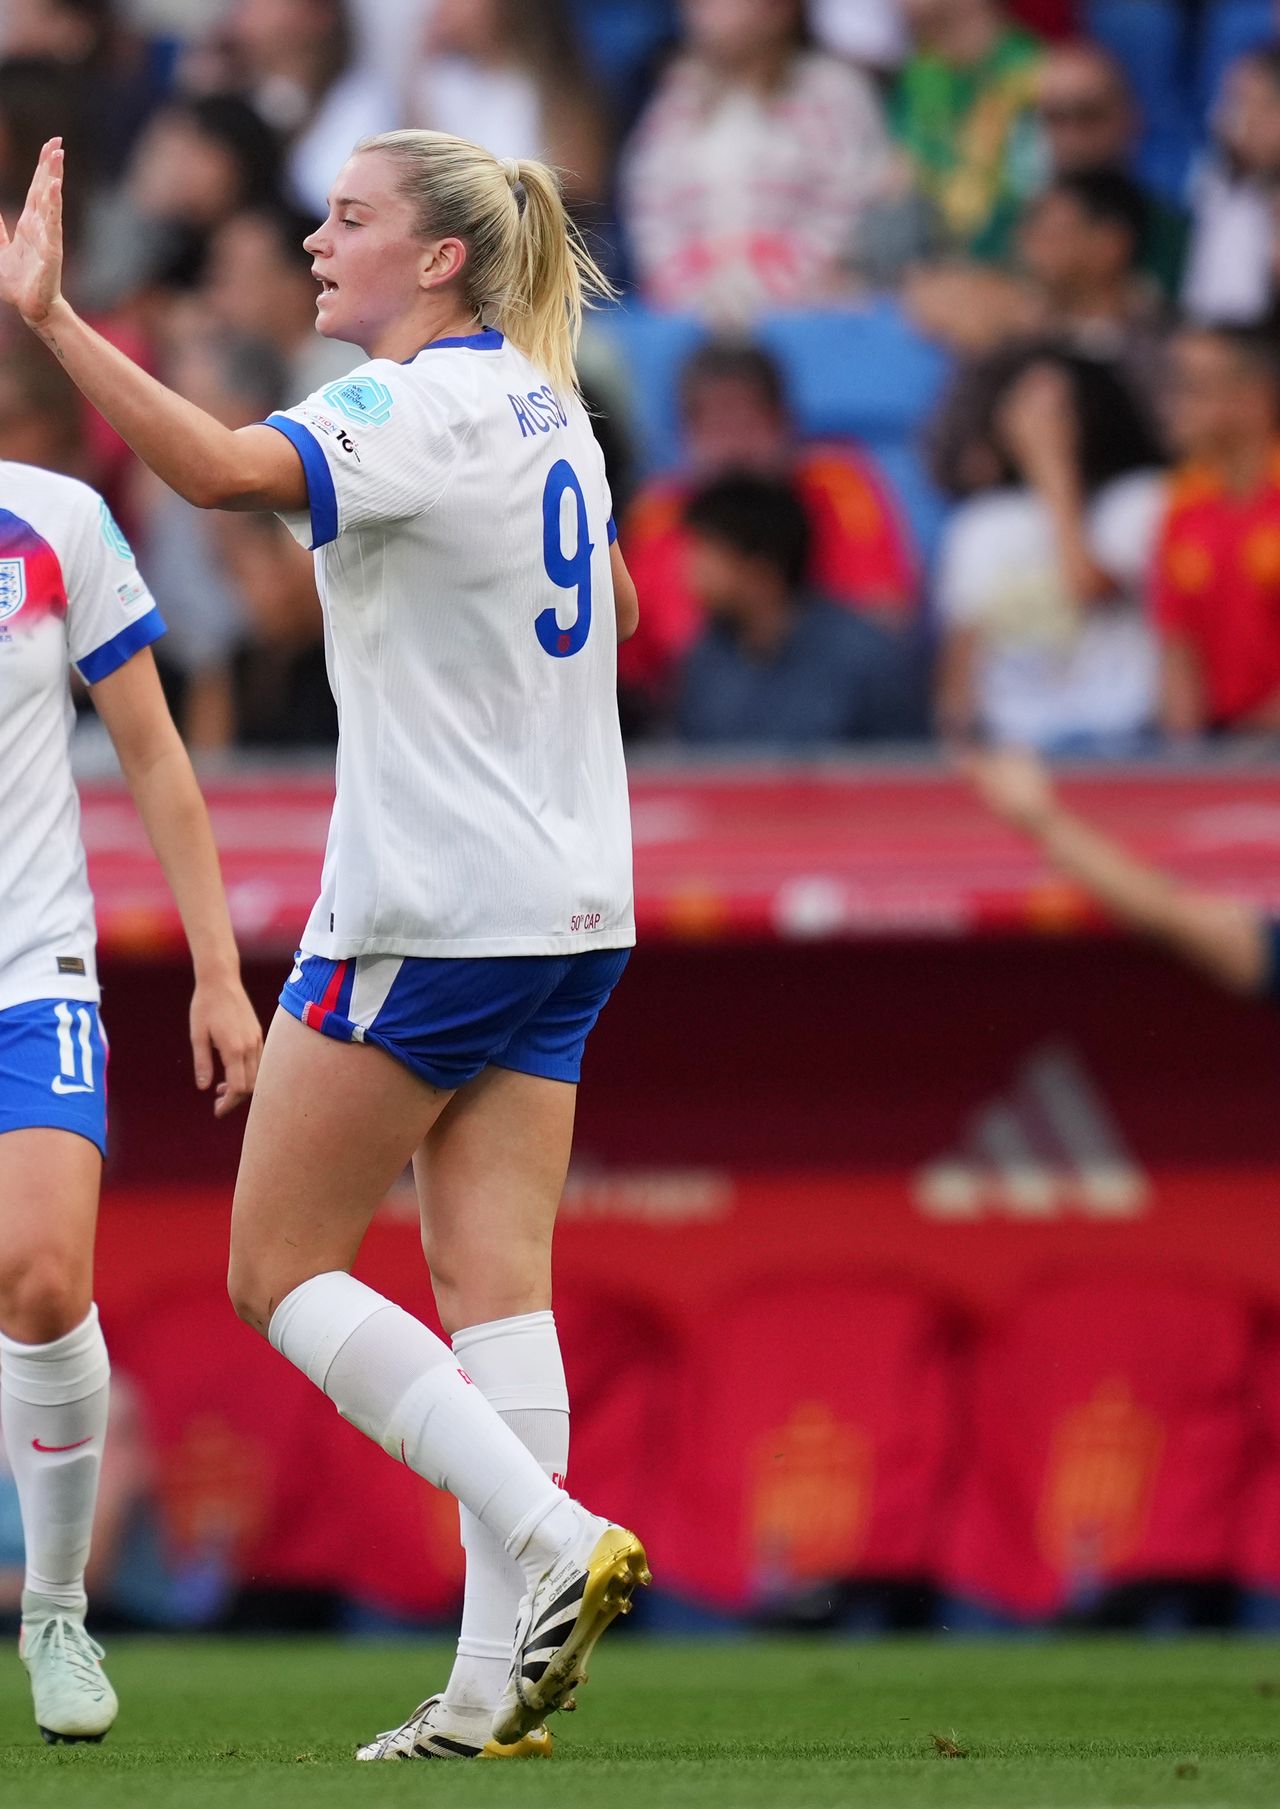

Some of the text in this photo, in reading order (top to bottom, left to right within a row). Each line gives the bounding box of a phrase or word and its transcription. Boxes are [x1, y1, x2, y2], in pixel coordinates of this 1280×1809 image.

[534, 458, 595, 658] 9
[584, 913, 601, 930] CAP
[53, 1001, 95, 1089] 11
